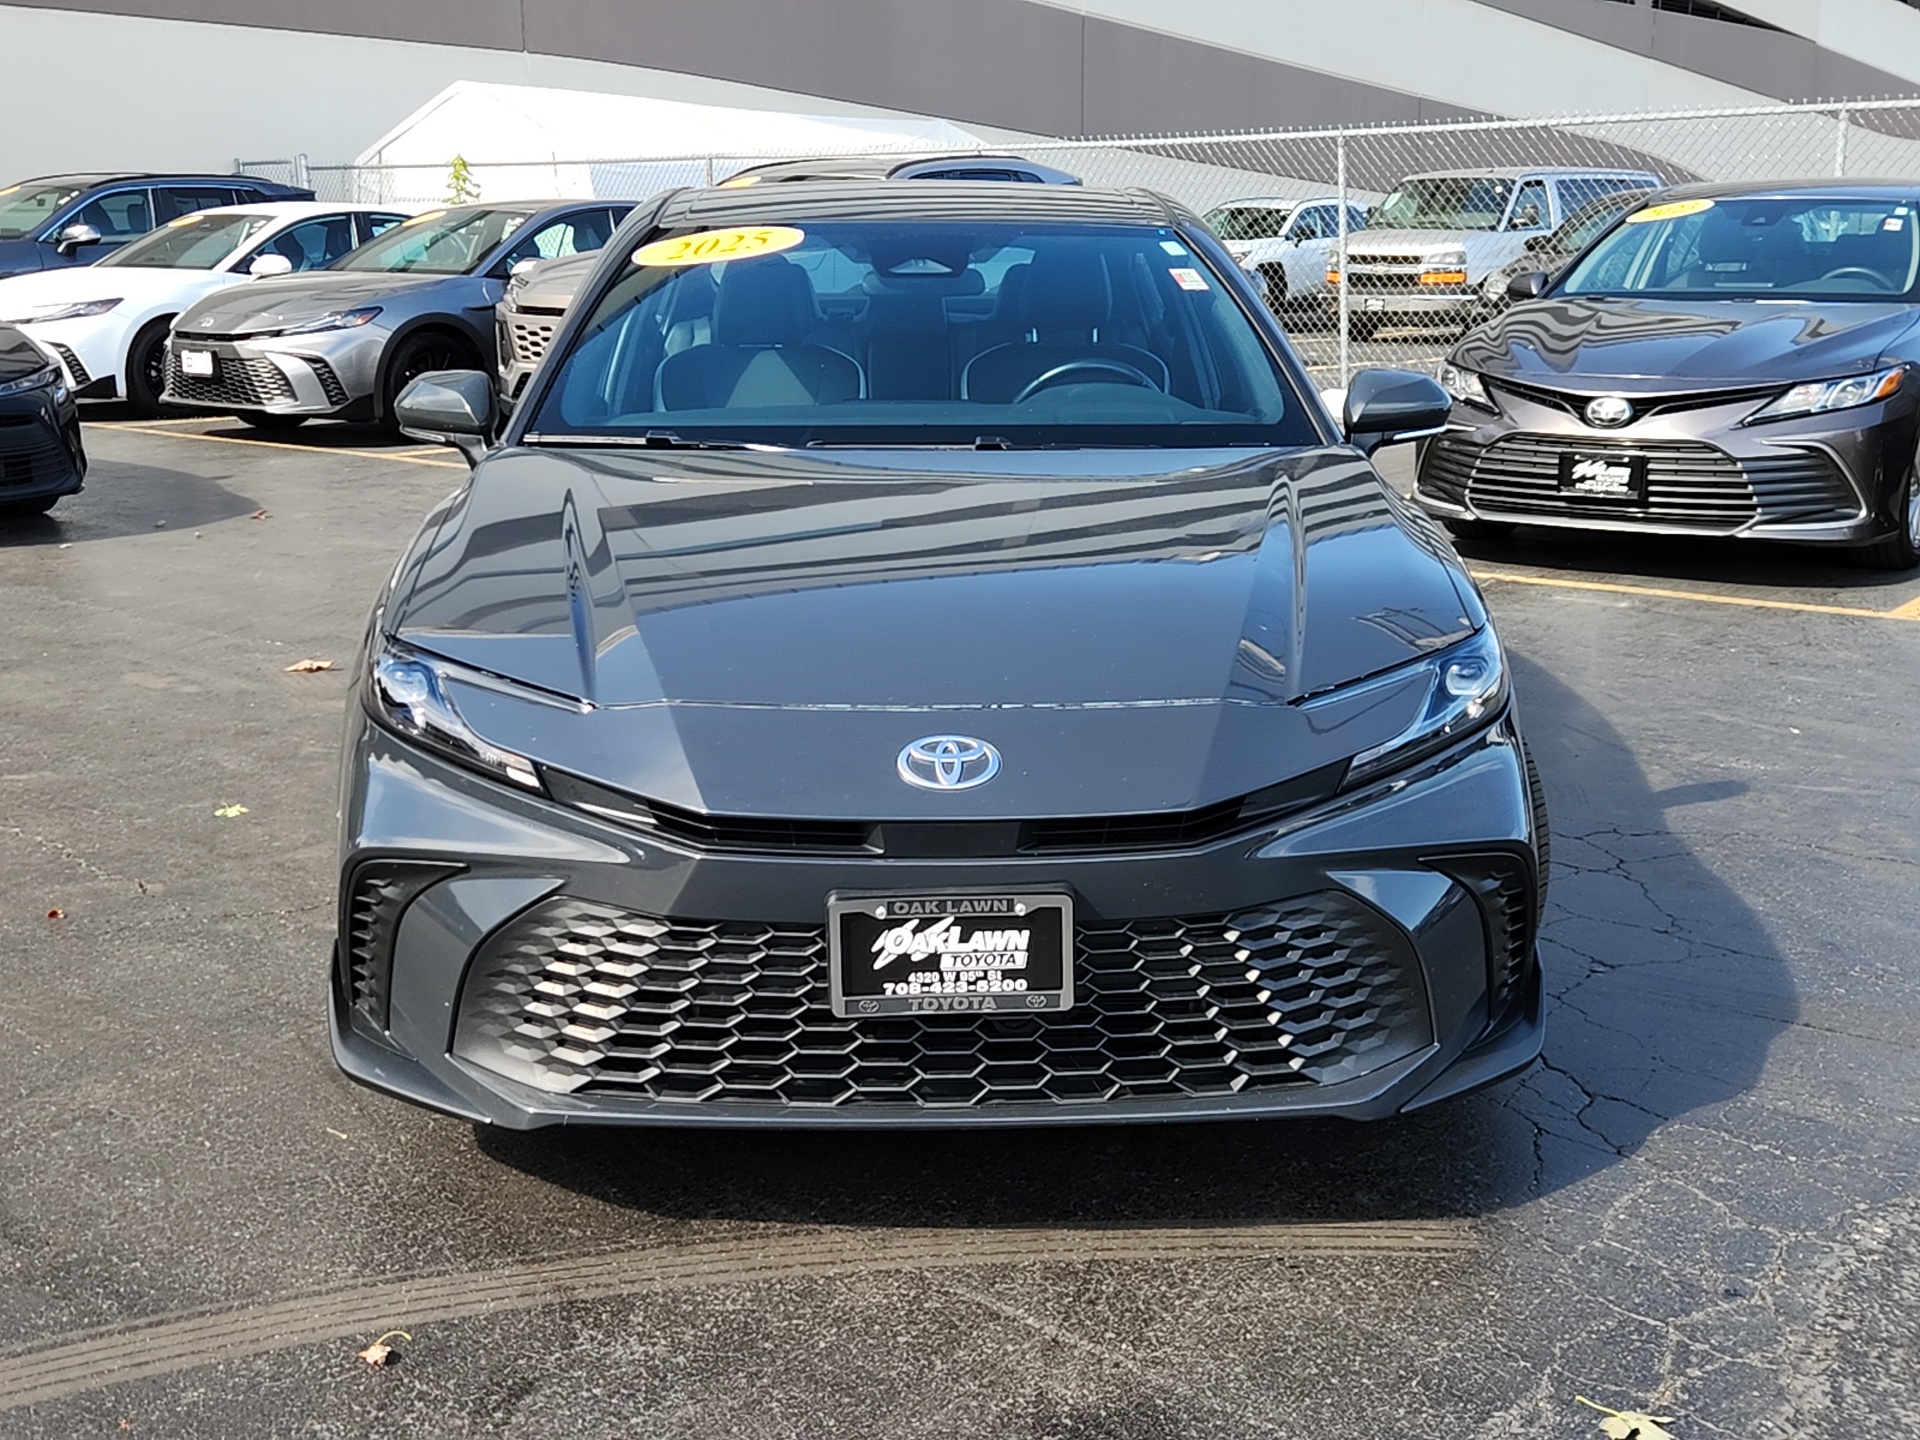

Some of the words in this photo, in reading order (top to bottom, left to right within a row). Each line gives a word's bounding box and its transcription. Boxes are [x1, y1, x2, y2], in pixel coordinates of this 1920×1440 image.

[667, 231, 773, 259] 2025
[894, 901, 939, 914] OAK
[946, 900, 1008, 913] LAWN
[951, 954, 1016, 967] TOYOTA
[908, 972, 941, 984] 4320
[943, 971, 957, 983] W
[987, 970, 1003, 981] St
[883, 979, 1028, 996] 708-423-5200
[908, 997, 997, 1011] TOYOTA
